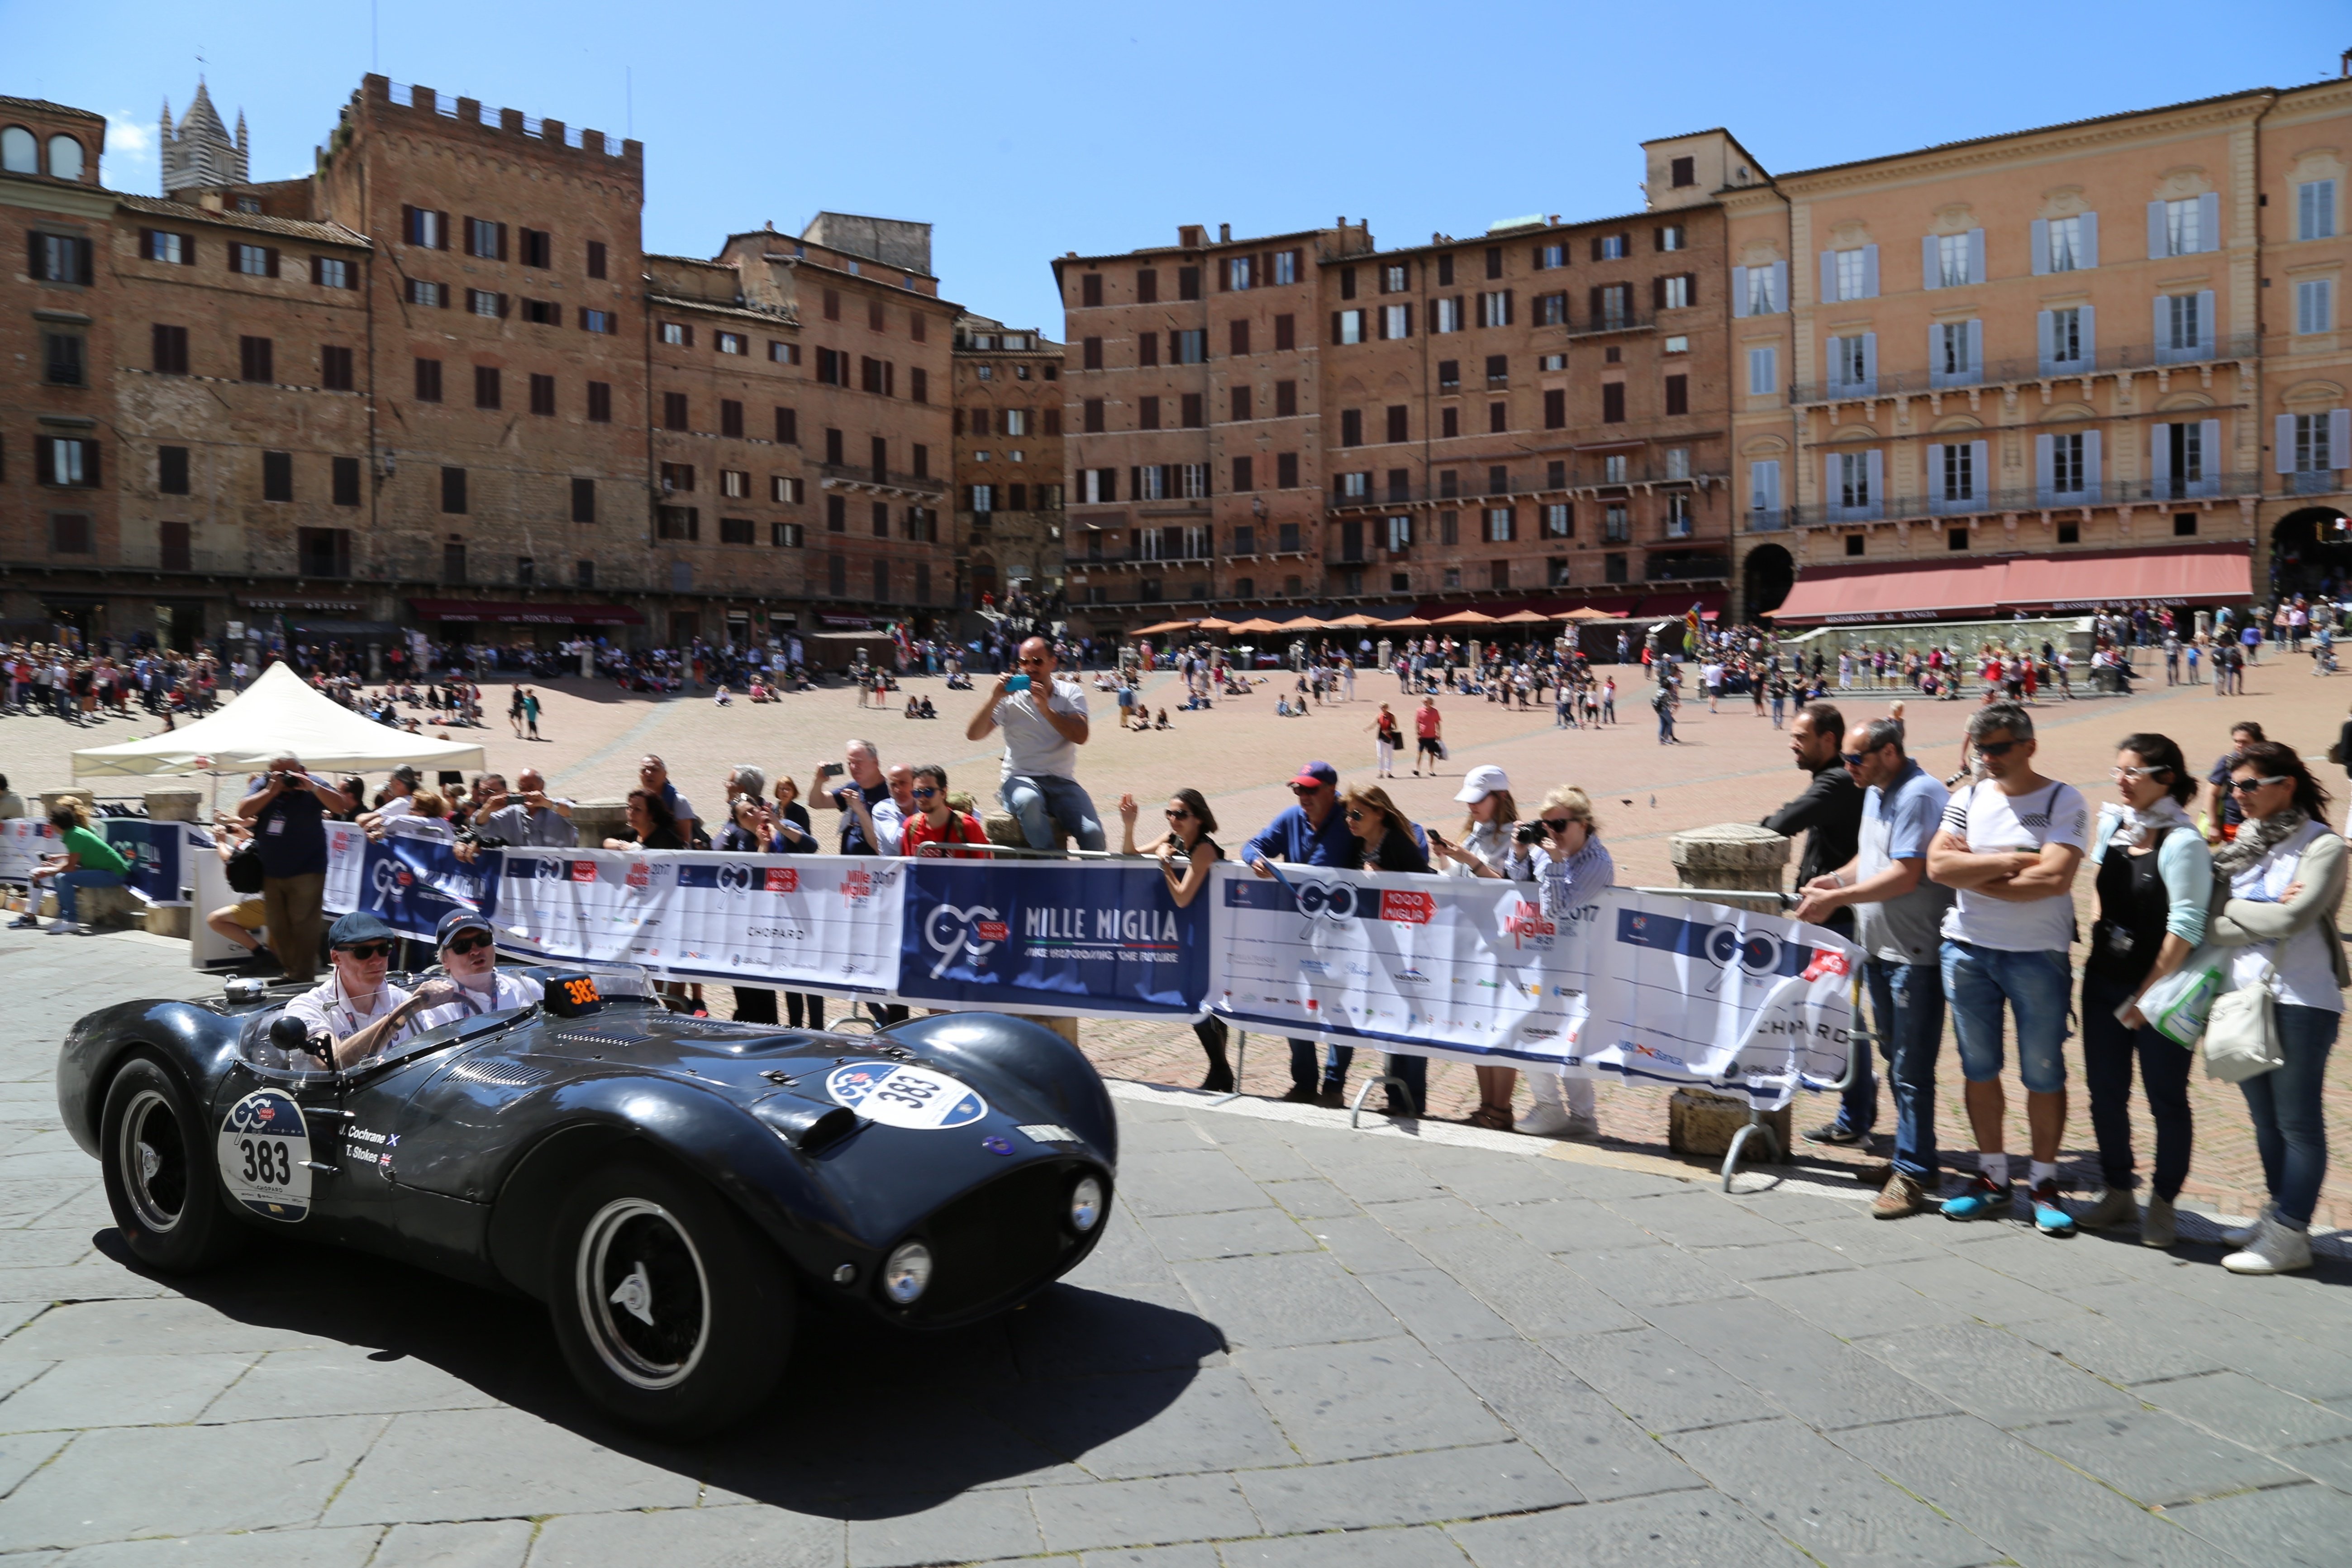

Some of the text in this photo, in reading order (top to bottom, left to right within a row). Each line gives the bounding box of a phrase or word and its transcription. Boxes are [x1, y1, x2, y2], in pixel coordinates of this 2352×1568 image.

[249, 601, 357, 610] FOTO OTTICA
[2052, 600, 2104, 610] BRASSERIE
[2107, 599, 2128, 608] BAR
[522, 613, 551, 623] FONTE
[1825, 613, 1878, 624] RISTORANTE
[1902, 610, 1938, 620] MANGIA
[651, 863, 671, 875] 2017
[770, 869, 793, 879] 1000
[847, 864, 897, 886] Mille 2017
[766, 881, 793, 890] MIGLIA
[840, 881, 871, 904] Miglia
[1387, 892, 1424, 906] 1000
[1383, 907, 1426, 922] MIGLIA
[1025, 907, 1179, 941] MILLE MIGLIA
[1505, 915, 1556, 944] Miglia
[747, 926, 805, 940] CHOPARD
[1116, 950, 1138, 962] THE
[1139, 951, 1179, 963] FUTURE
[564, 978, 600, 1005] 383
[1618, 1039, 1683, 1067] UBI Banca
[878, 1075, 940, 1109] 383
[339, 1124, 386, 1144] J. Cochrane
[346, 1144, 378, 1163] T. Stokes
[240, 1139, 291, 1186] 383
